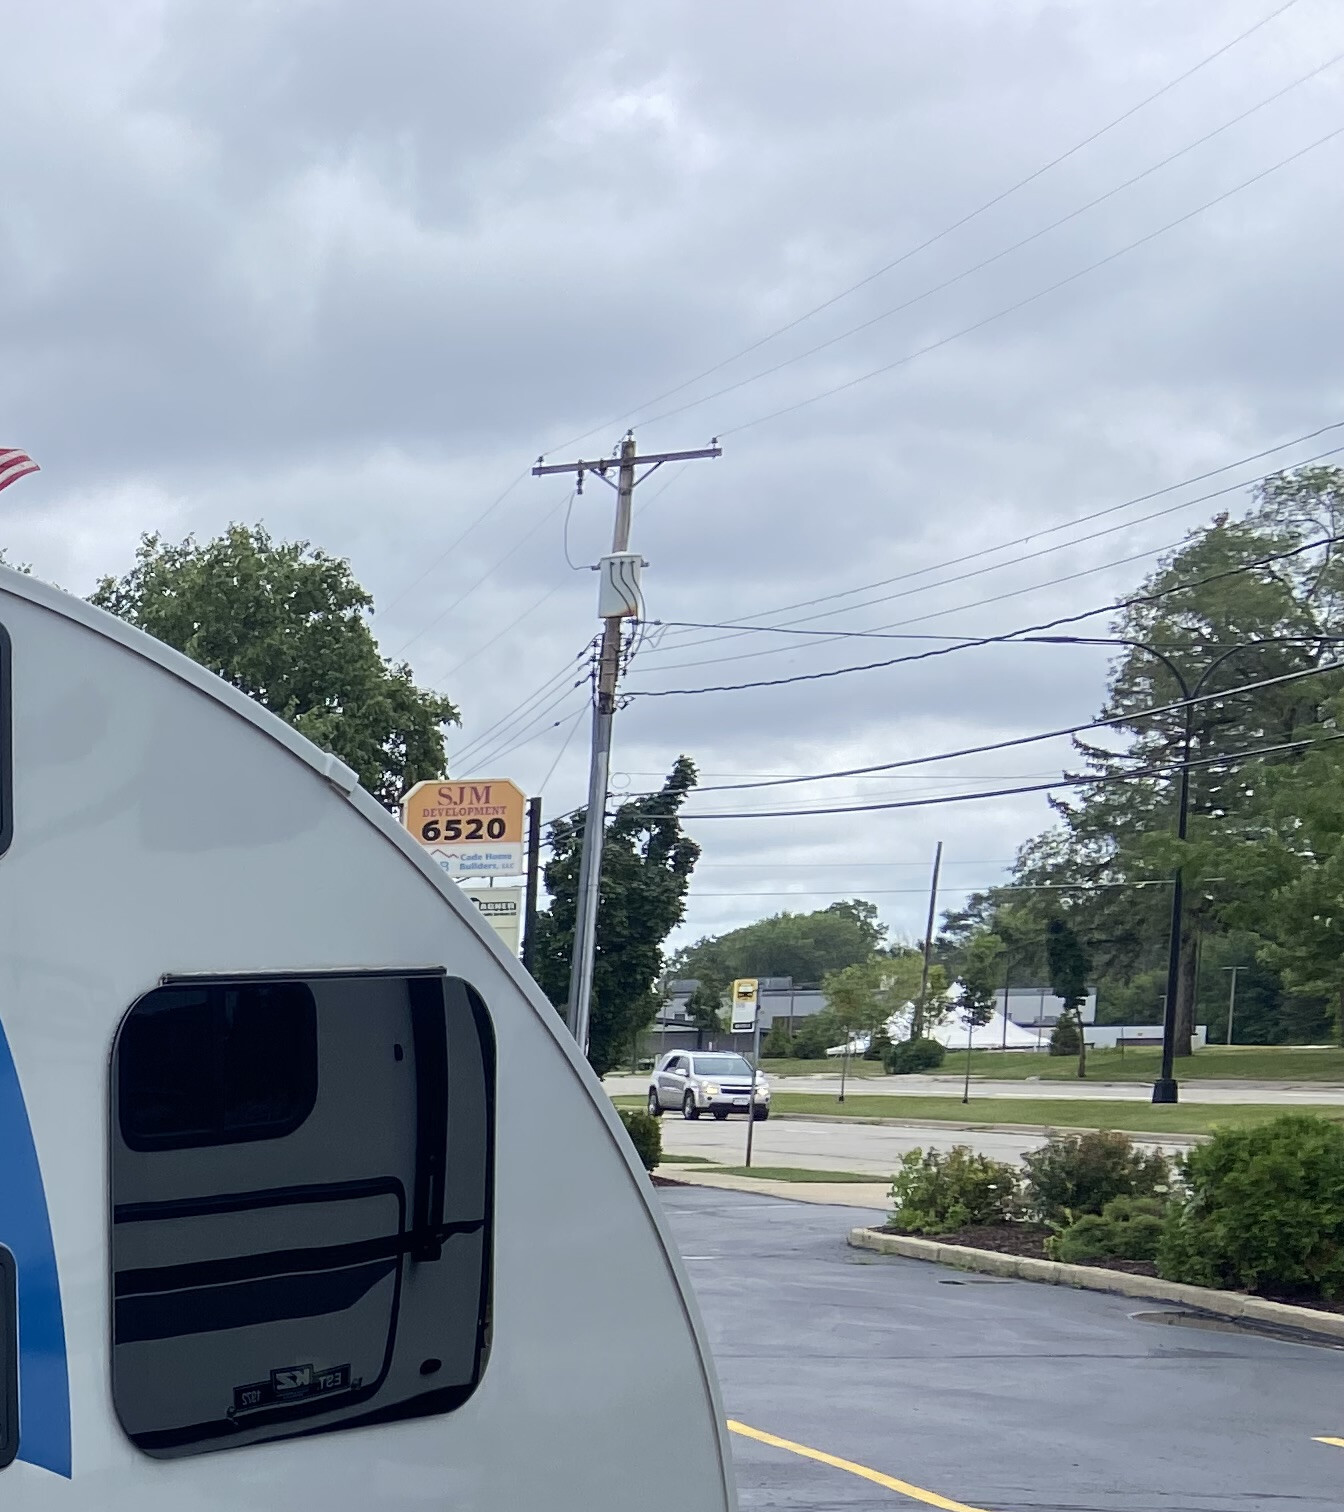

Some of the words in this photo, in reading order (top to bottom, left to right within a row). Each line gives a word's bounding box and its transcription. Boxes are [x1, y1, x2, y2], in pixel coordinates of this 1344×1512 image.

[438, 786, 492, 805] SJM
[422, 806, 507, 817] DEVELOPMENT
[422, 818, 506, 841] 6520
